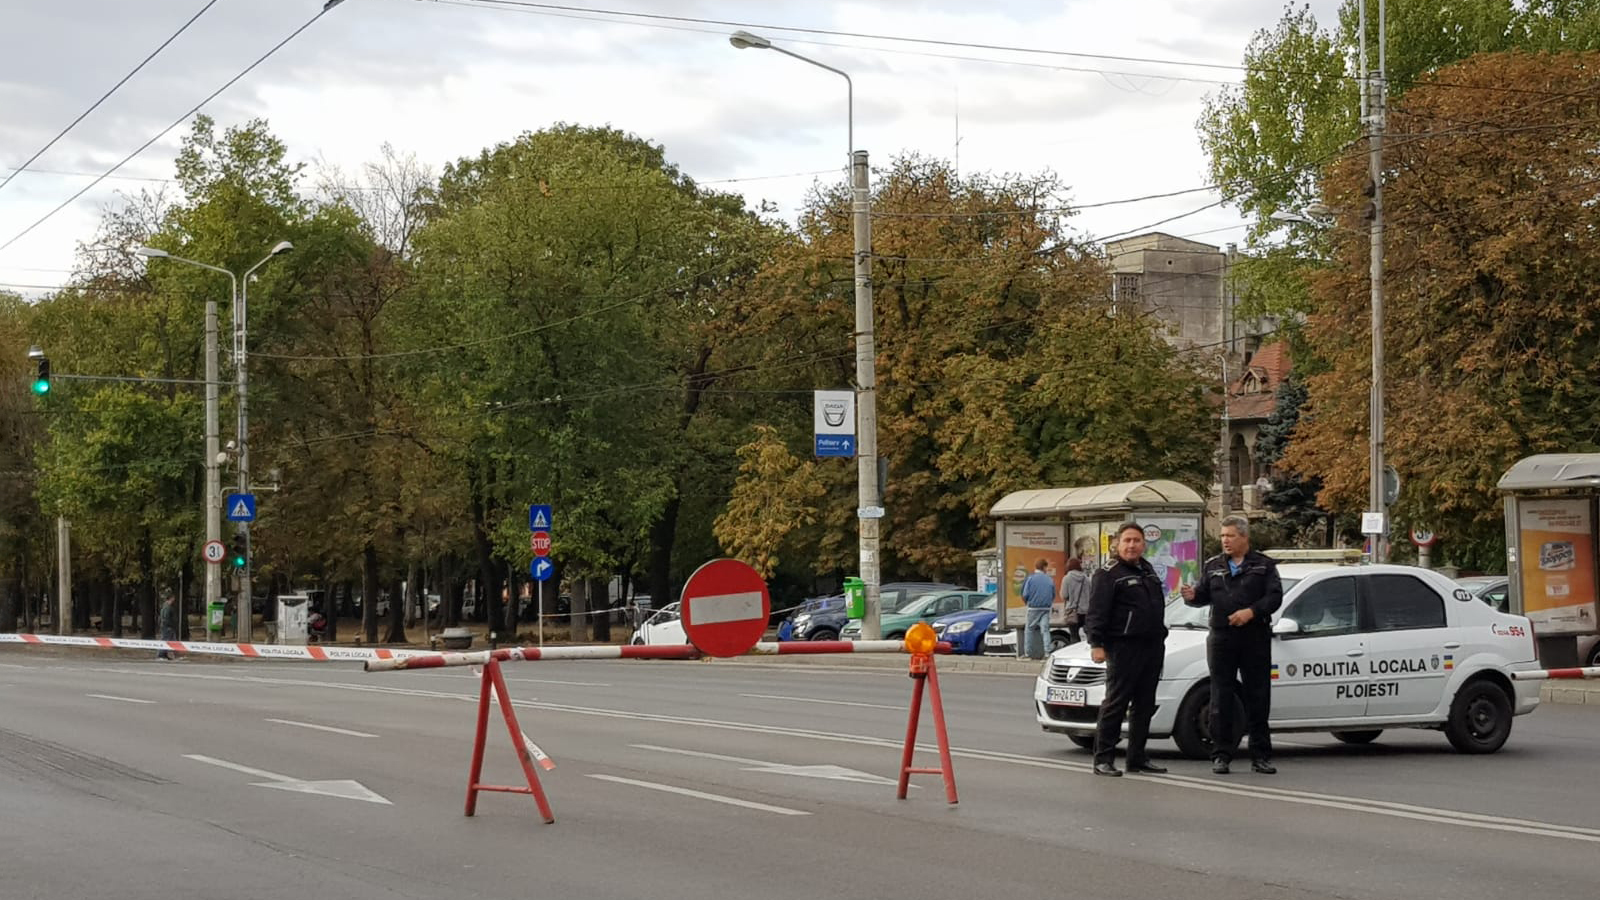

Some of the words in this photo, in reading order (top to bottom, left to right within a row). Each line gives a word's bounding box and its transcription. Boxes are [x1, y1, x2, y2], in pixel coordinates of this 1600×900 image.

[532, 538, 551, 549] STOP
[1303, 661, 1360, 677] POLITIA
[1370, 658, 1427, 674] LOCALA
[1070, 690, 1084, 701] PLP
[1336, 682, 1399, 699] PLOIESTI
